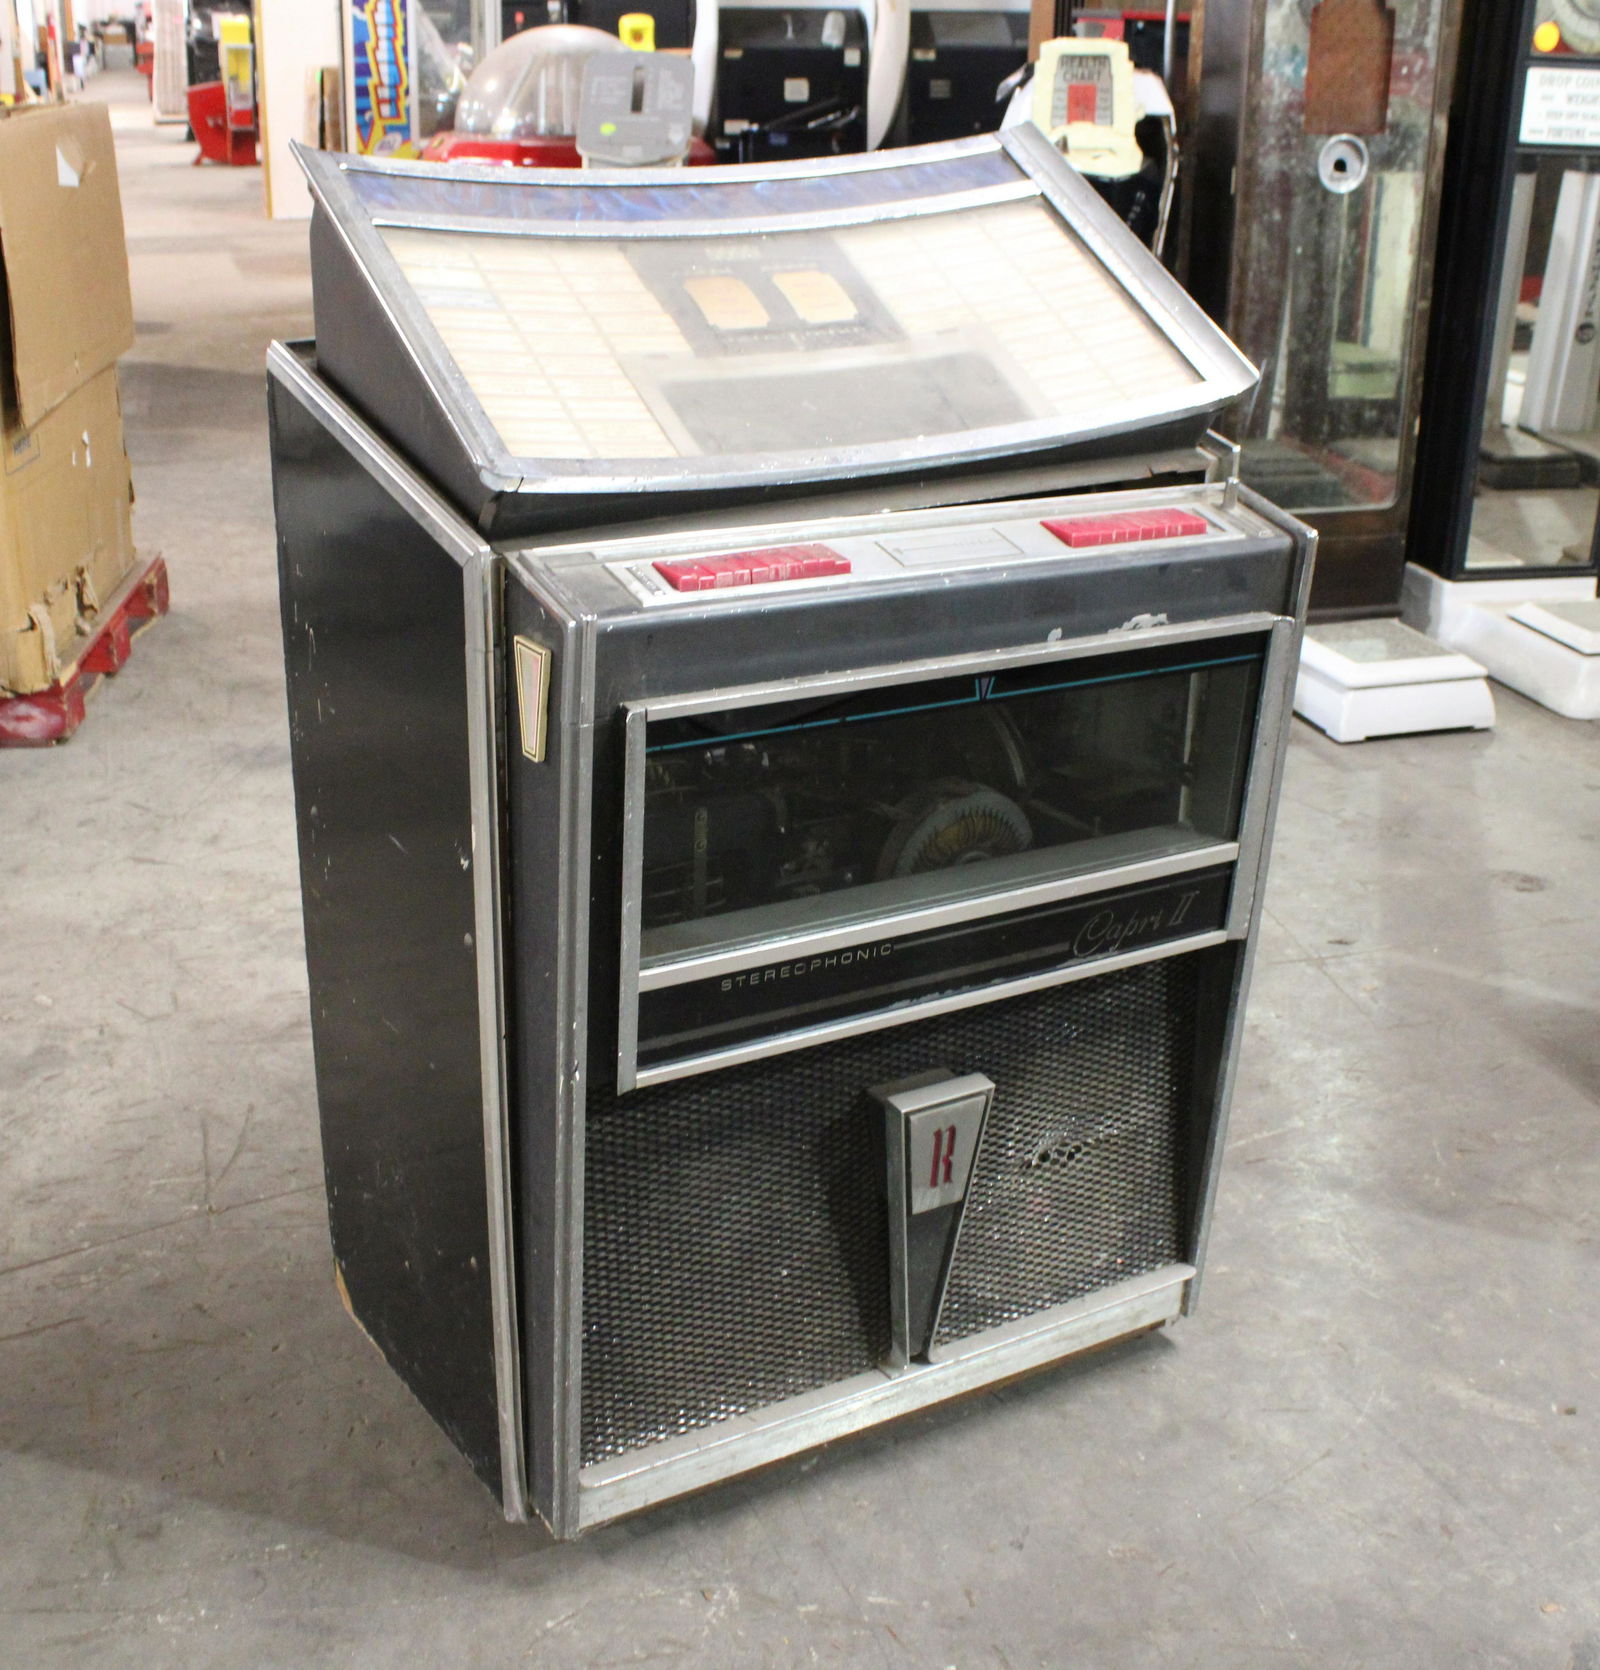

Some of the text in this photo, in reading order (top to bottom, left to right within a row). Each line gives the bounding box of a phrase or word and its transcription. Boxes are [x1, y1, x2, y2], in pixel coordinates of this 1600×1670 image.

[1062, 69, 1103, 82] CHART
[1539, 74, 1571, 88] DROP
[1072, 890, 1200, 957] Capri II
[721, 943, 892, 991] STEREOPHONIC
